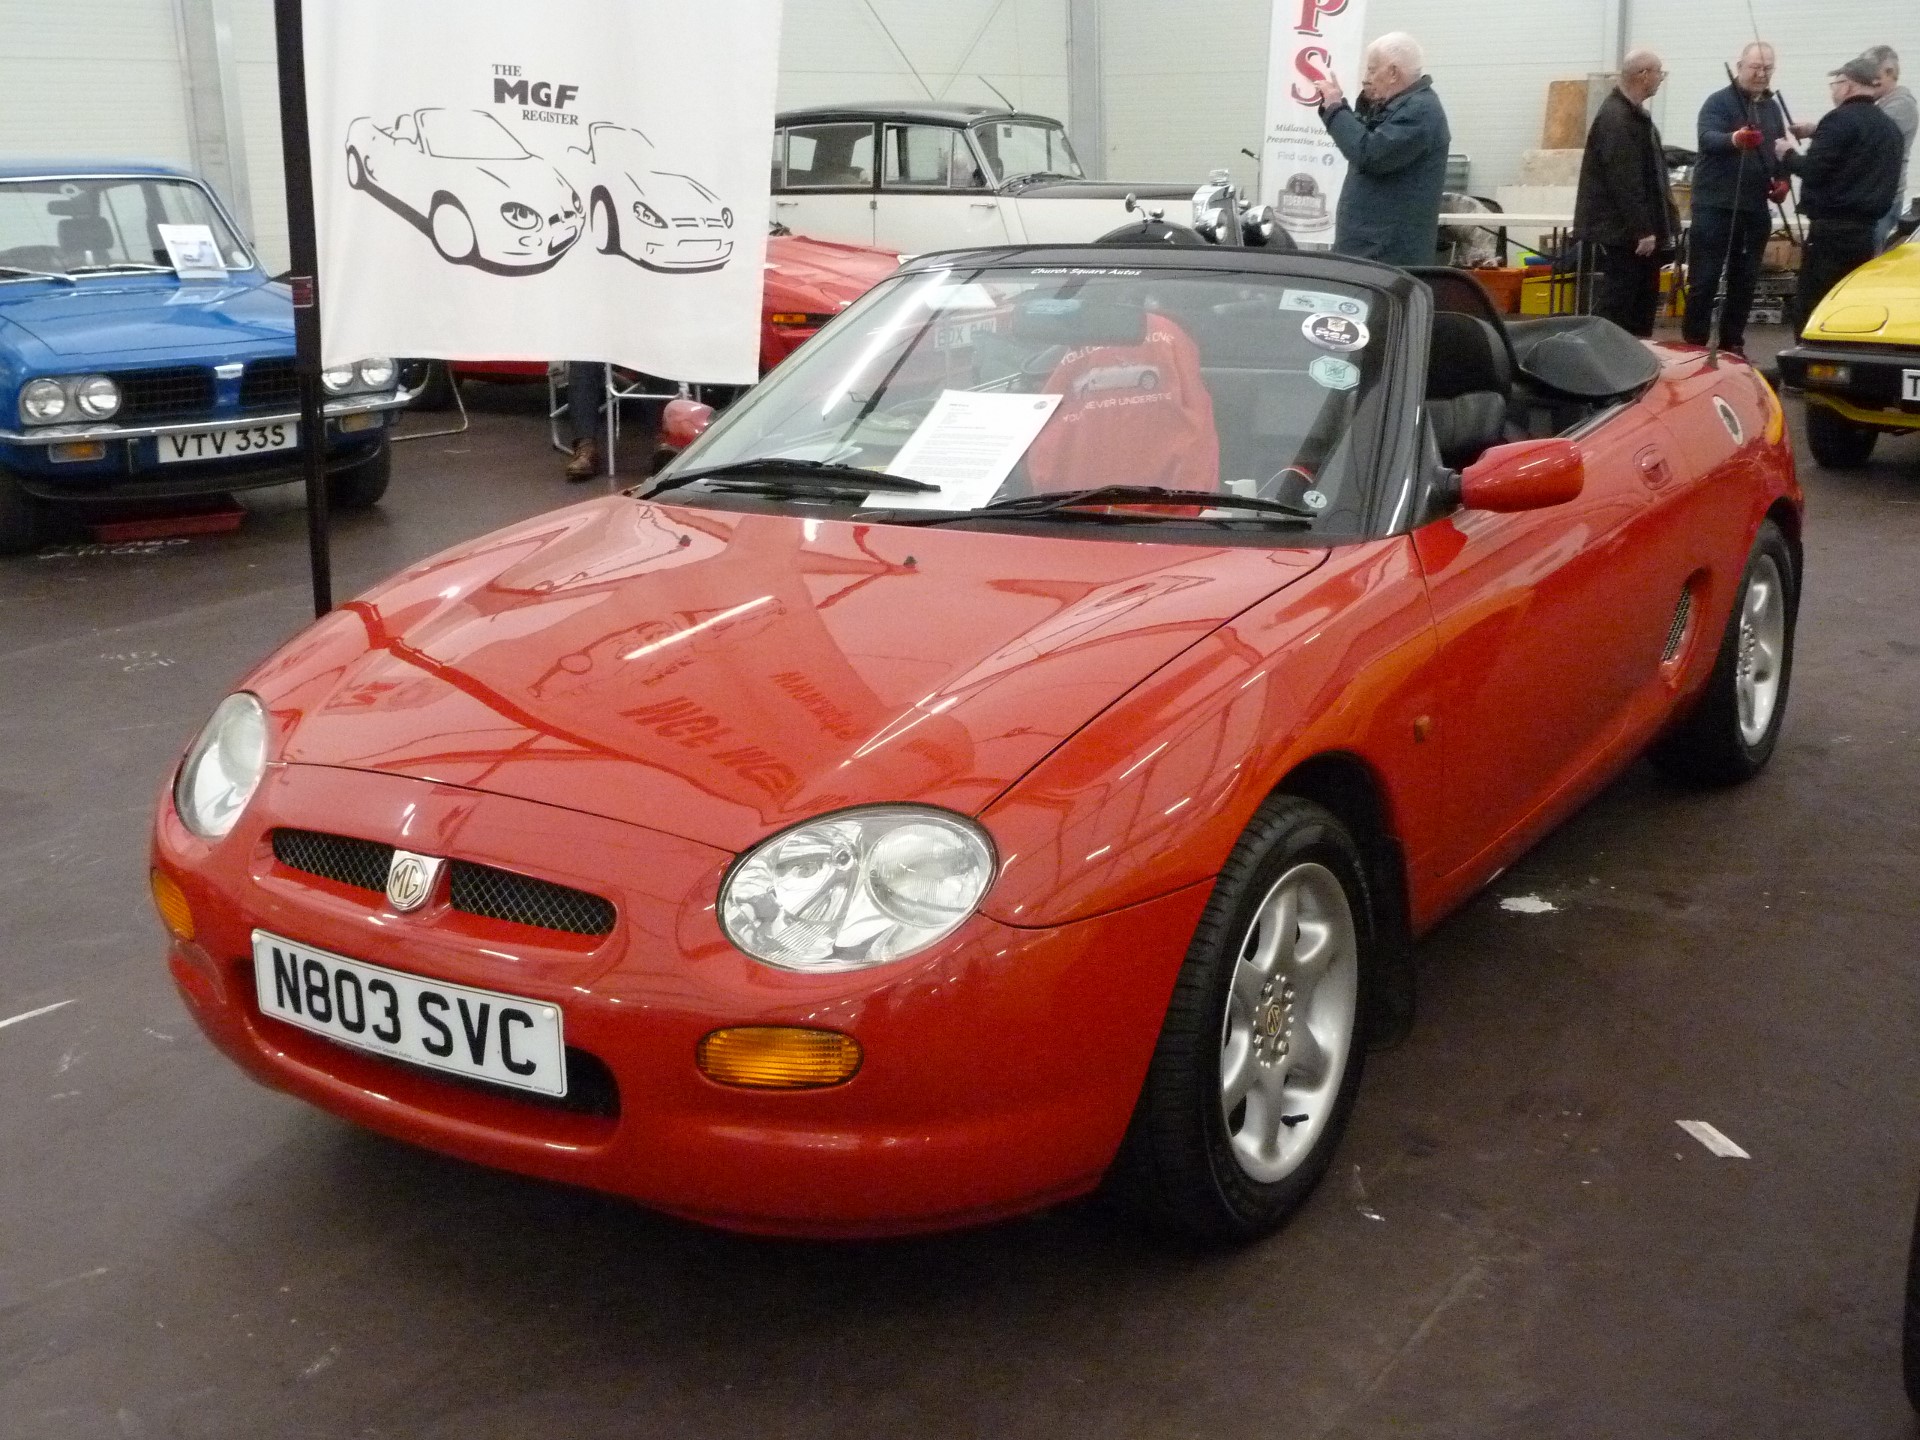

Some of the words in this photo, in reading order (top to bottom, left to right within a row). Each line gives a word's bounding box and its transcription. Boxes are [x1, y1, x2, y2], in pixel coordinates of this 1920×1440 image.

[492, 64, 521, 77] THE
[493, 78, 579, 109] MGF
[522, 109, 579, 126] REGISTER
[171, 431, 226, 458] VTV
[235, 424, 286, 451] 33S
[392, 864, 419, 900] MG
[272, 946, 402, 1045] N803
[417, 990, 538, 1077] SVC
